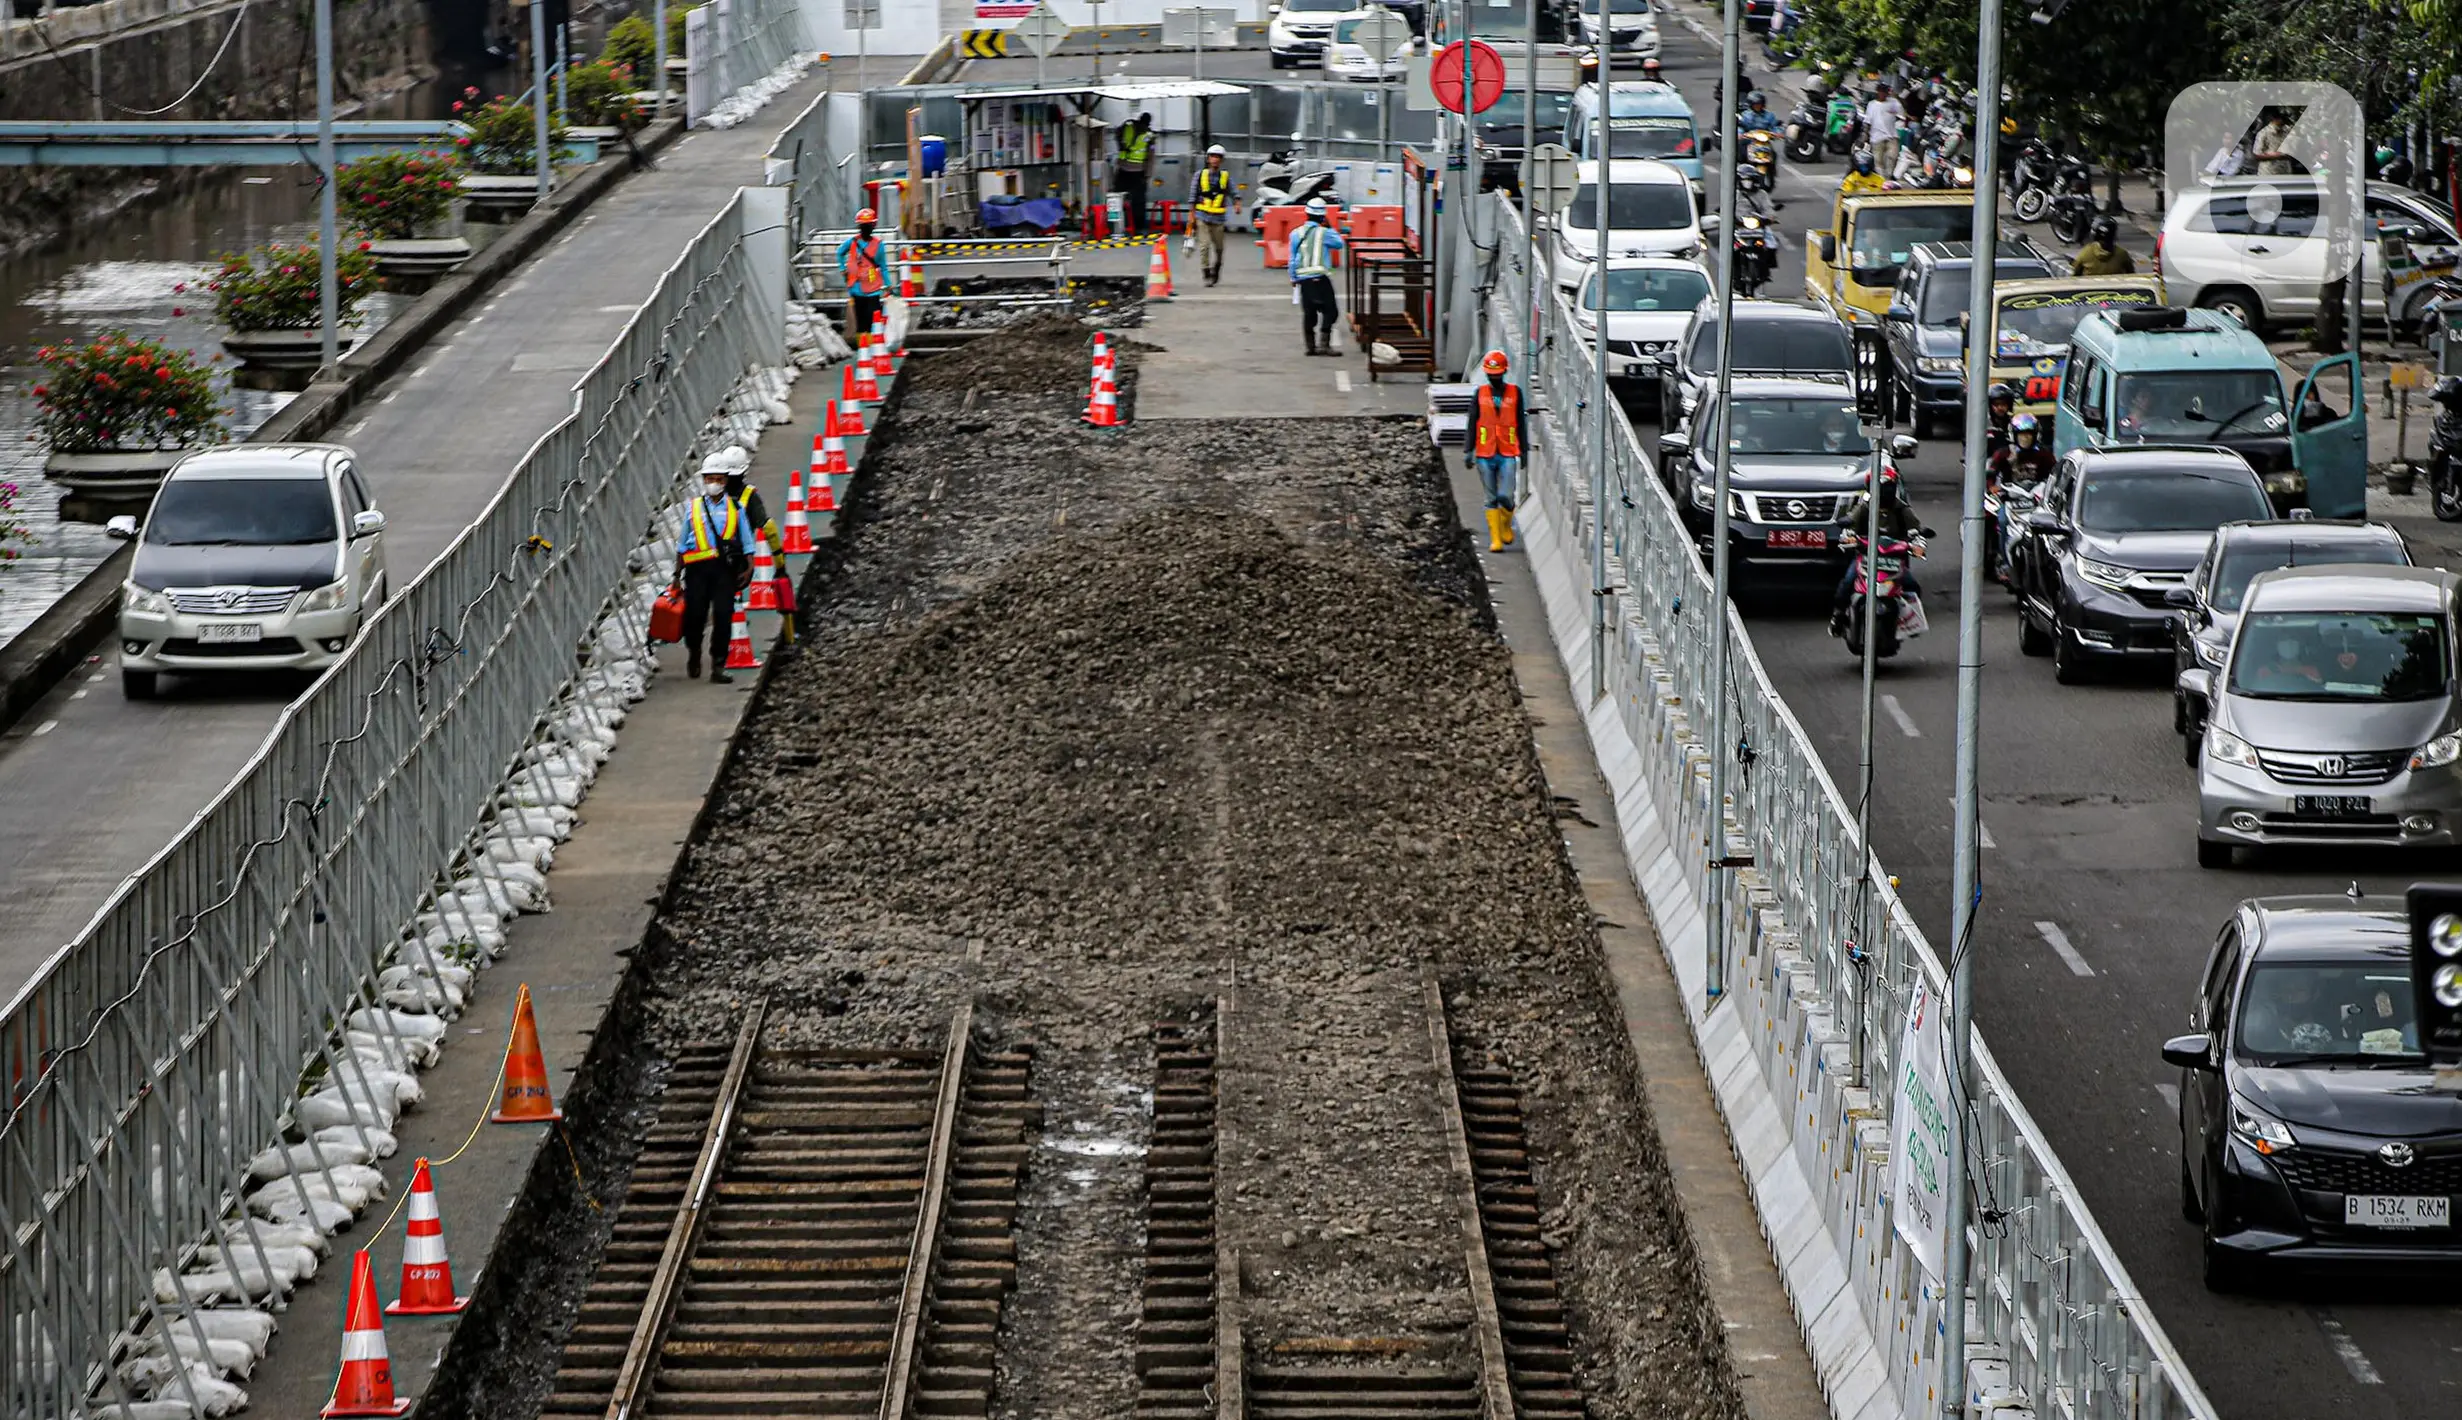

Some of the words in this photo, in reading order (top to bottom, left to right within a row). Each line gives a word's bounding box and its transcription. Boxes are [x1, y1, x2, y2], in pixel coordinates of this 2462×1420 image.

[2349, 1198, 2359, 1215] B
[2369, 1198, 2406, 1217] 1534
[2416, 1199, 2448, 1219] RKM
